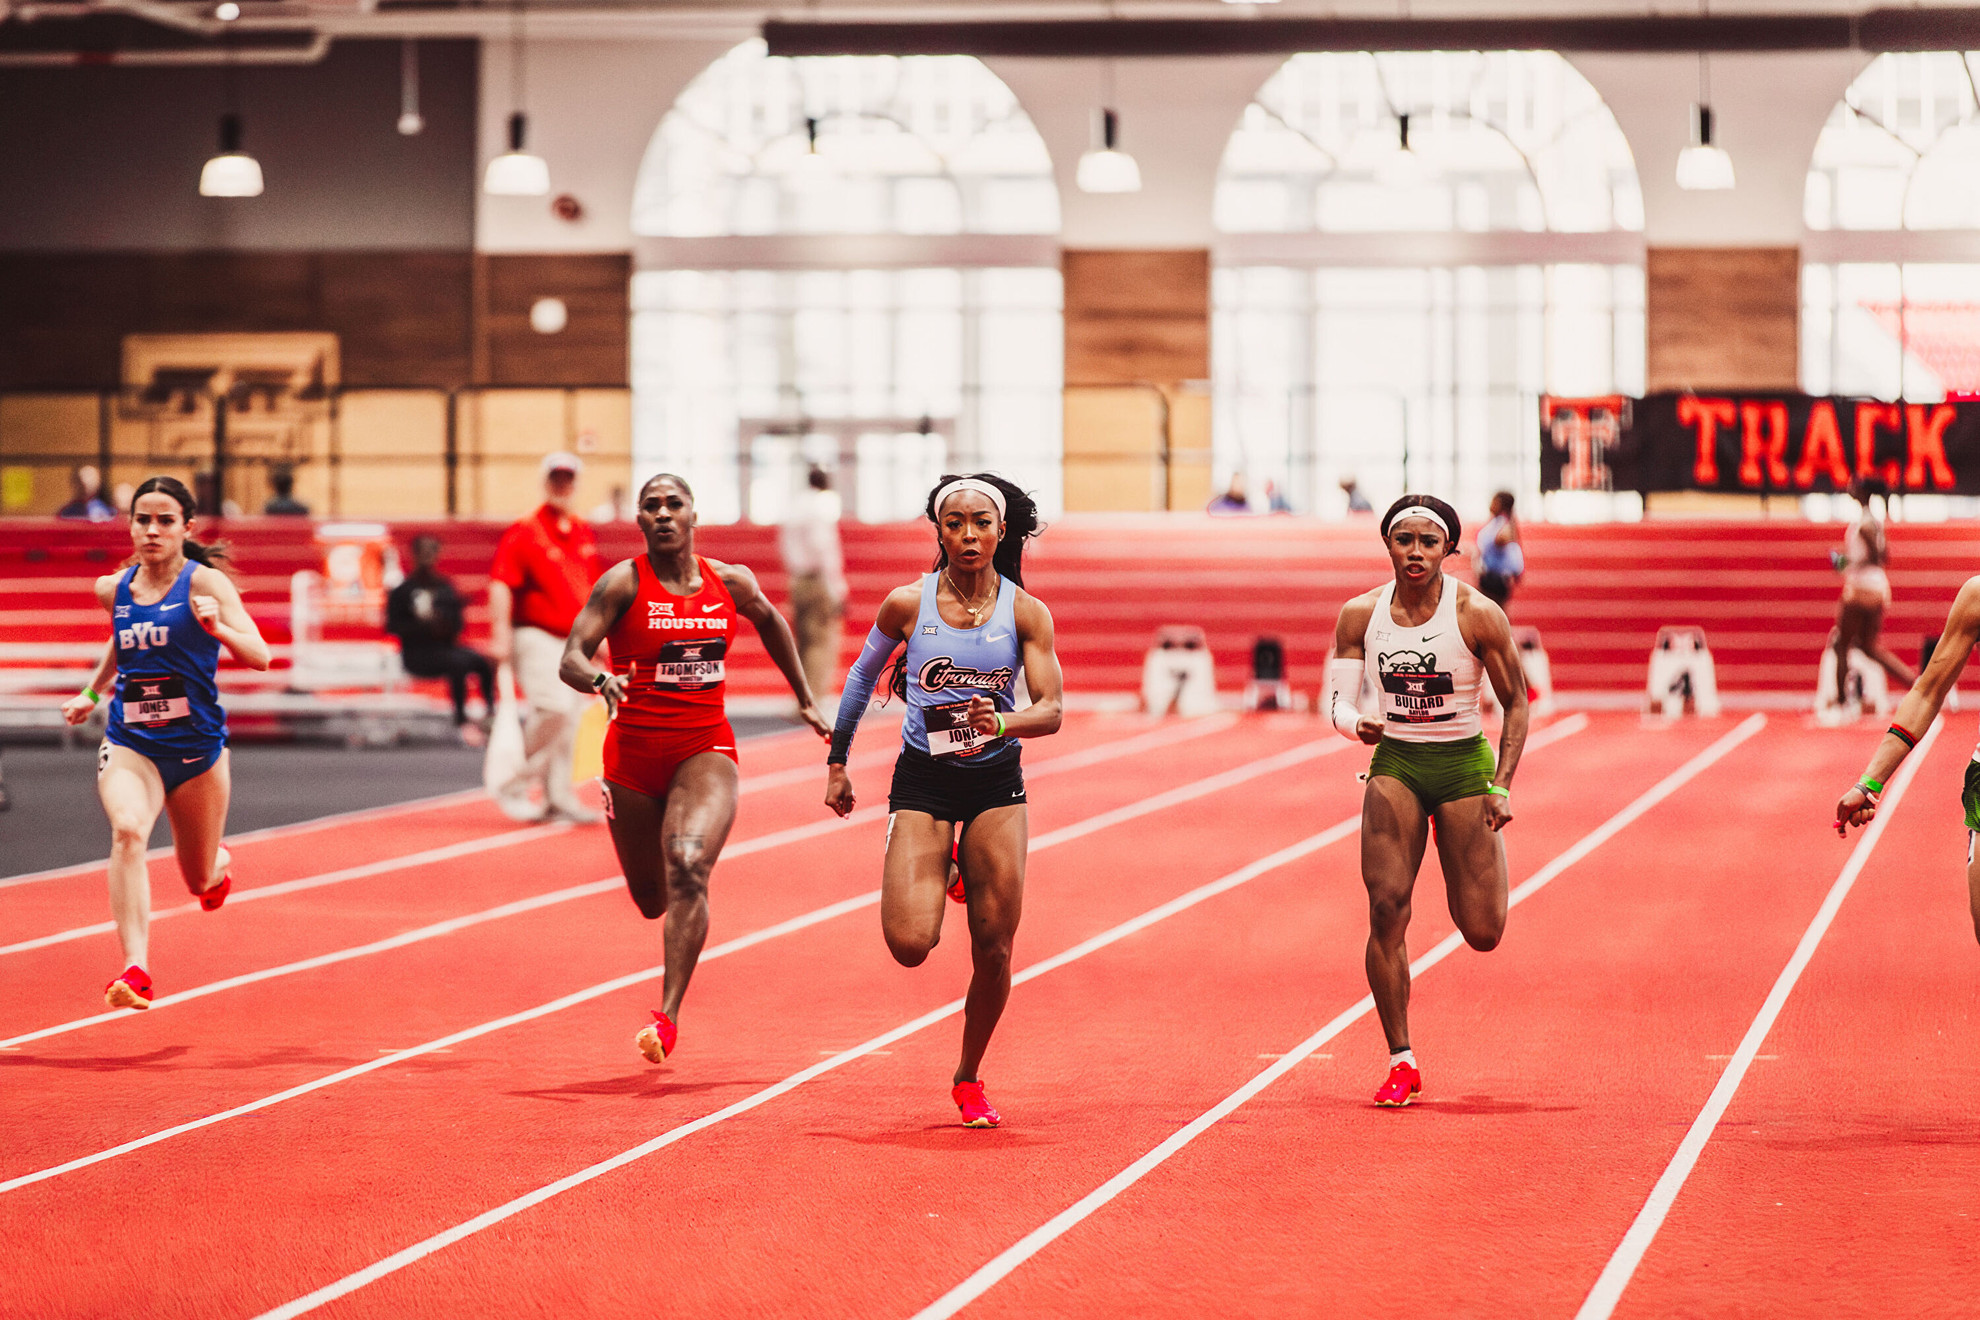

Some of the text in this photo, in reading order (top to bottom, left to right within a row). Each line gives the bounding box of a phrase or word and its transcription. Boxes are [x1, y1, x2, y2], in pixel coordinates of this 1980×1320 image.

[1676, 398, 1957, 488] TRACK
[648, 618, 728, 629] HOUSTON
[119, 621, 169, 650] BYU
[661, 662, 720, 675] THOMPSON
[918, 656, 1013, 694] Citronauts
[139, 701, 170, 714] JONES
[1395, 695, 1444, 709] BULLARD
